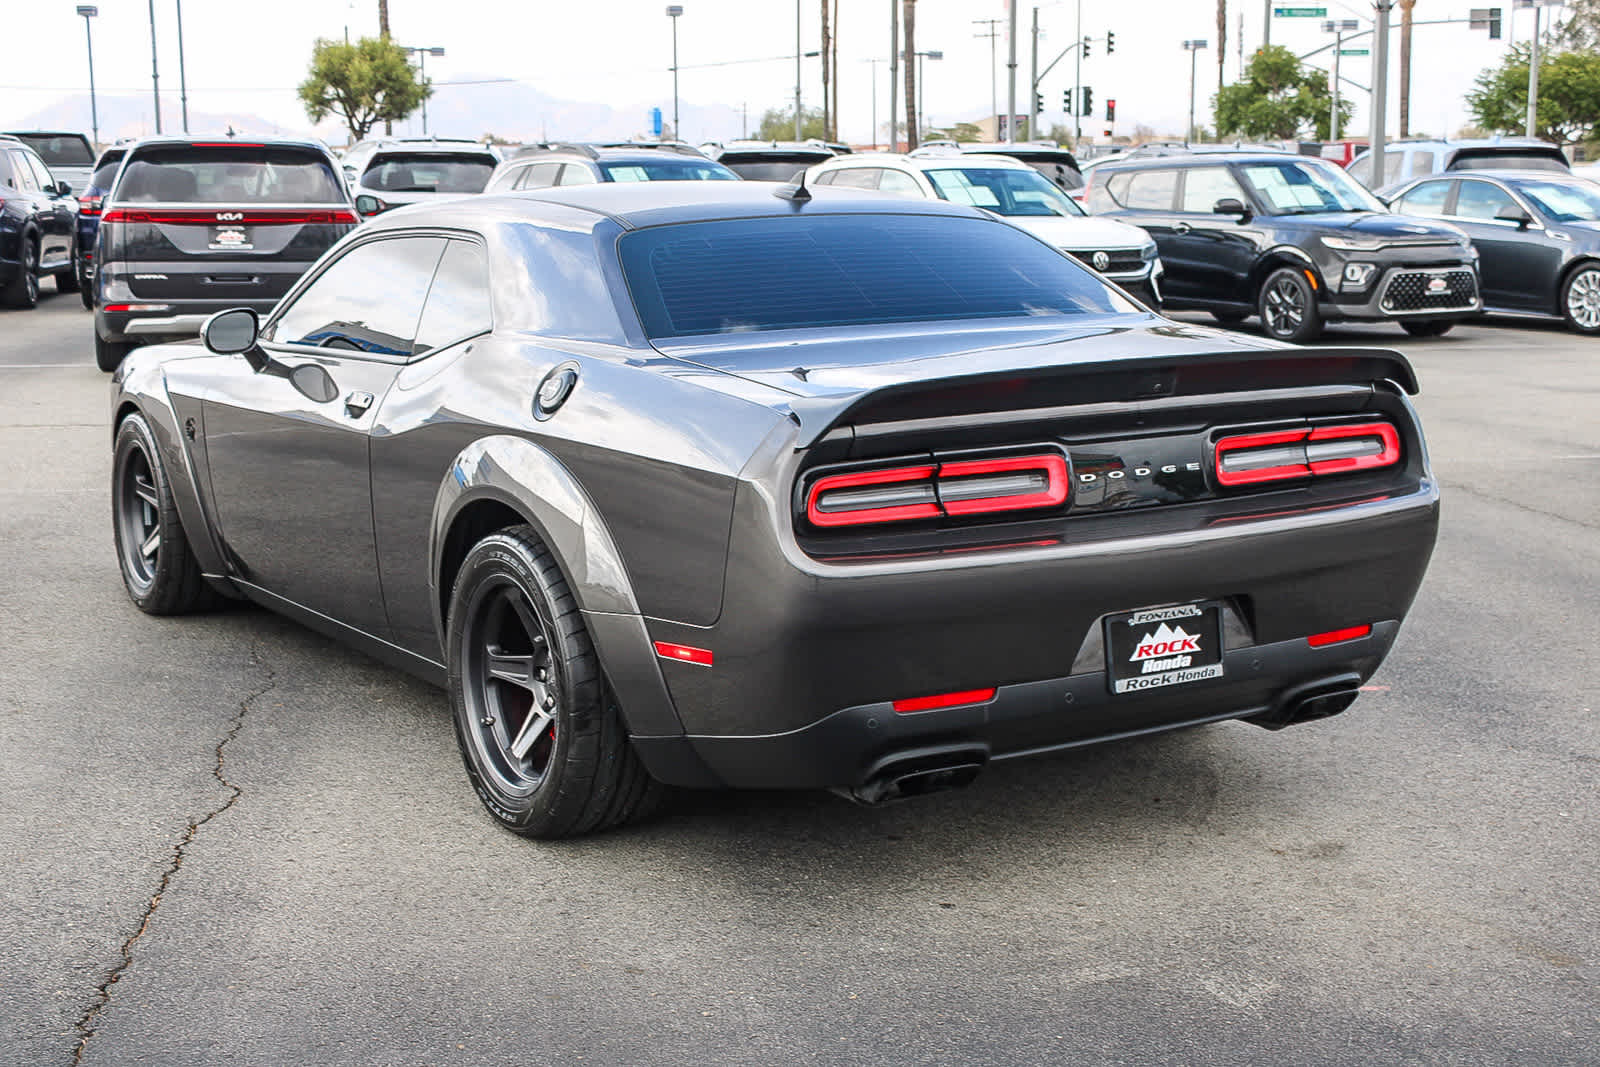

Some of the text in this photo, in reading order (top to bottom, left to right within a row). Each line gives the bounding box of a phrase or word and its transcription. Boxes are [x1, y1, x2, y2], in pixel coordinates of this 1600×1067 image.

[1080, 462, 1200, 482] DODGE
[1138, 608, 1194, 622] FONTANA
[1137, 637, 1196, 658] ROCK
[1141, 655, 1192, 674] Honda
[1126, 667, 1216, 690] Rock Honda
